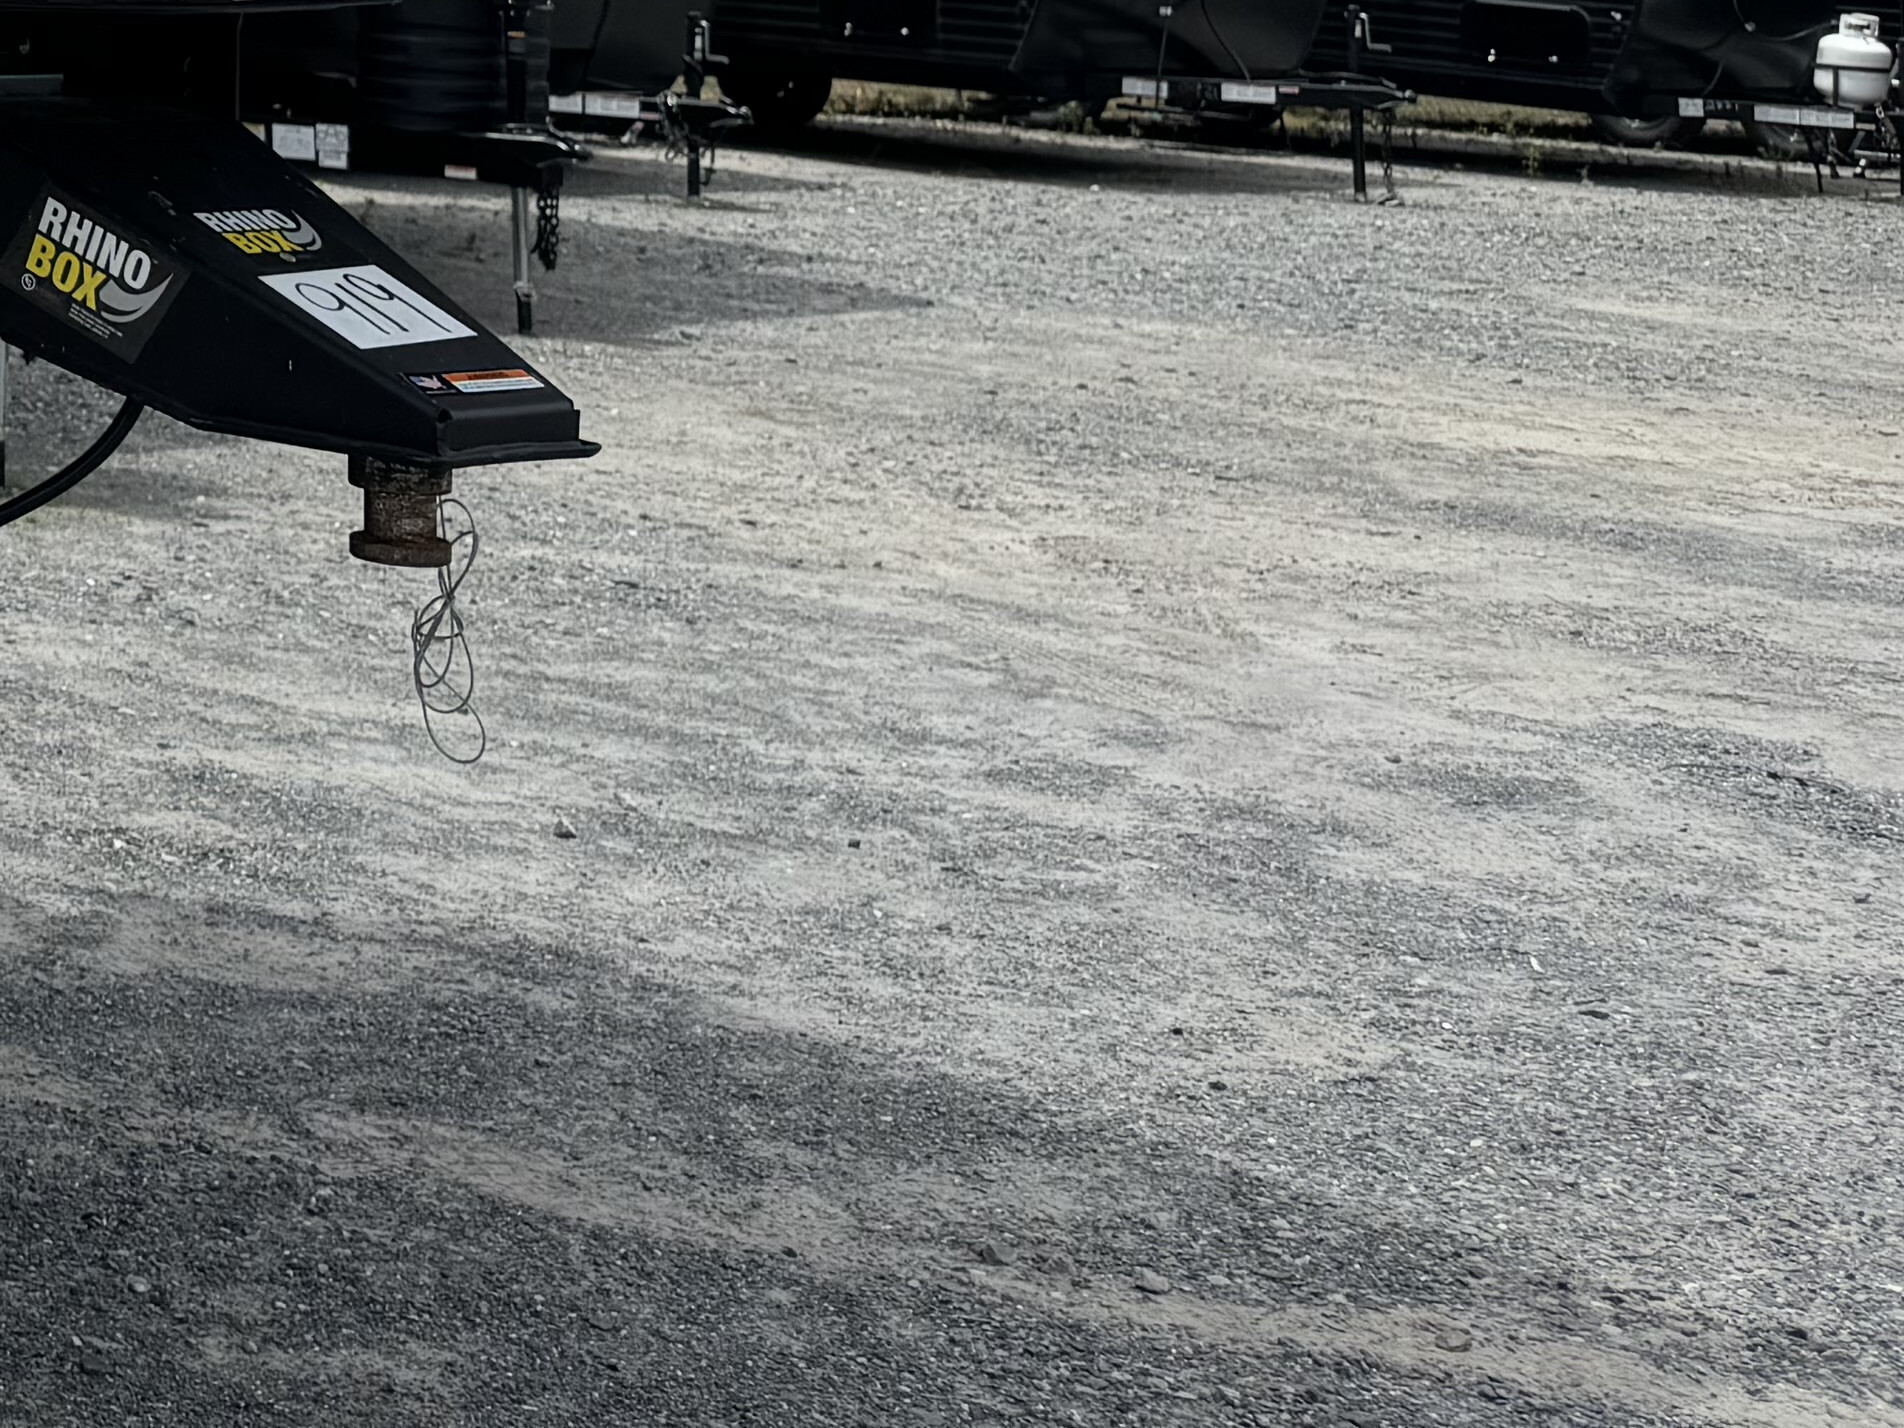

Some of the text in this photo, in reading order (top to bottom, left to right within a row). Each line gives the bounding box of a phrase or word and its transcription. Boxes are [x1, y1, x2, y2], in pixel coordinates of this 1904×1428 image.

[38, 196, 152, 290] RHINO
[193, 208, 297, 233] RHINO
[221, 229, 305, 255] BOX
[25, 232, 107, 312] BOX
[294, 273, 453, 336] 919
